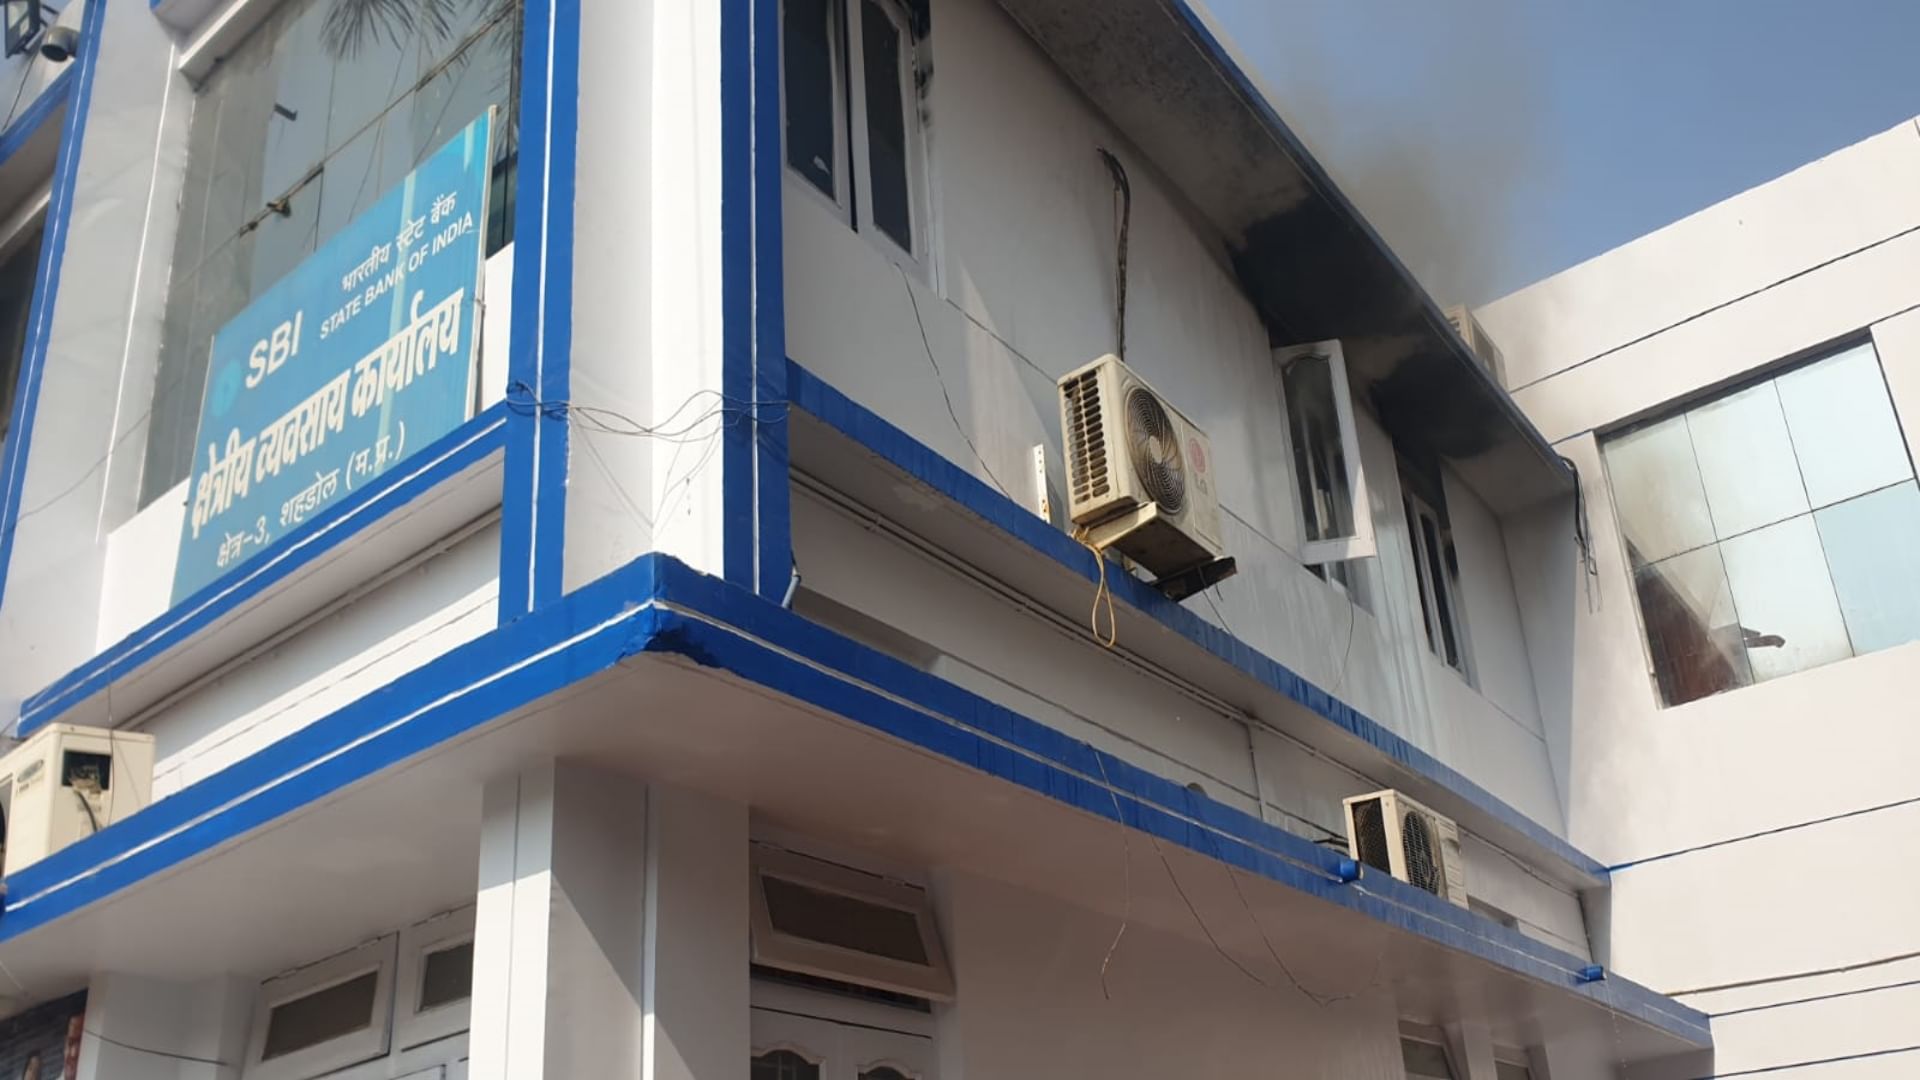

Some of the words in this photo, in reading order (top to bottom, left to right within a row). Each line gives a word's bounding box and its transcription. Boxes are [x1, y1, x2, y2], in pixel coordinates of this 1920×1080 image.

[320, 294, 362, 340] STATE
[364, 262, 405, 306] BANK
[408, 243, 430, 272] OF
[432, 210, 473, 256] INDIA
[342, 241, 392, 292] भारतीय
[395, 215, 427, 251] स्टेट
[430, 191, 457, 224] बैंक
[245, 309, 303, 389] SBI
[191, 427, 258, 540] क्षेत्रीय
[255, 368, 351, 484] व्यवसाय
[351, 287, 465, 418] कार्यालय
[279, 468, 341, 526] शहडोल
